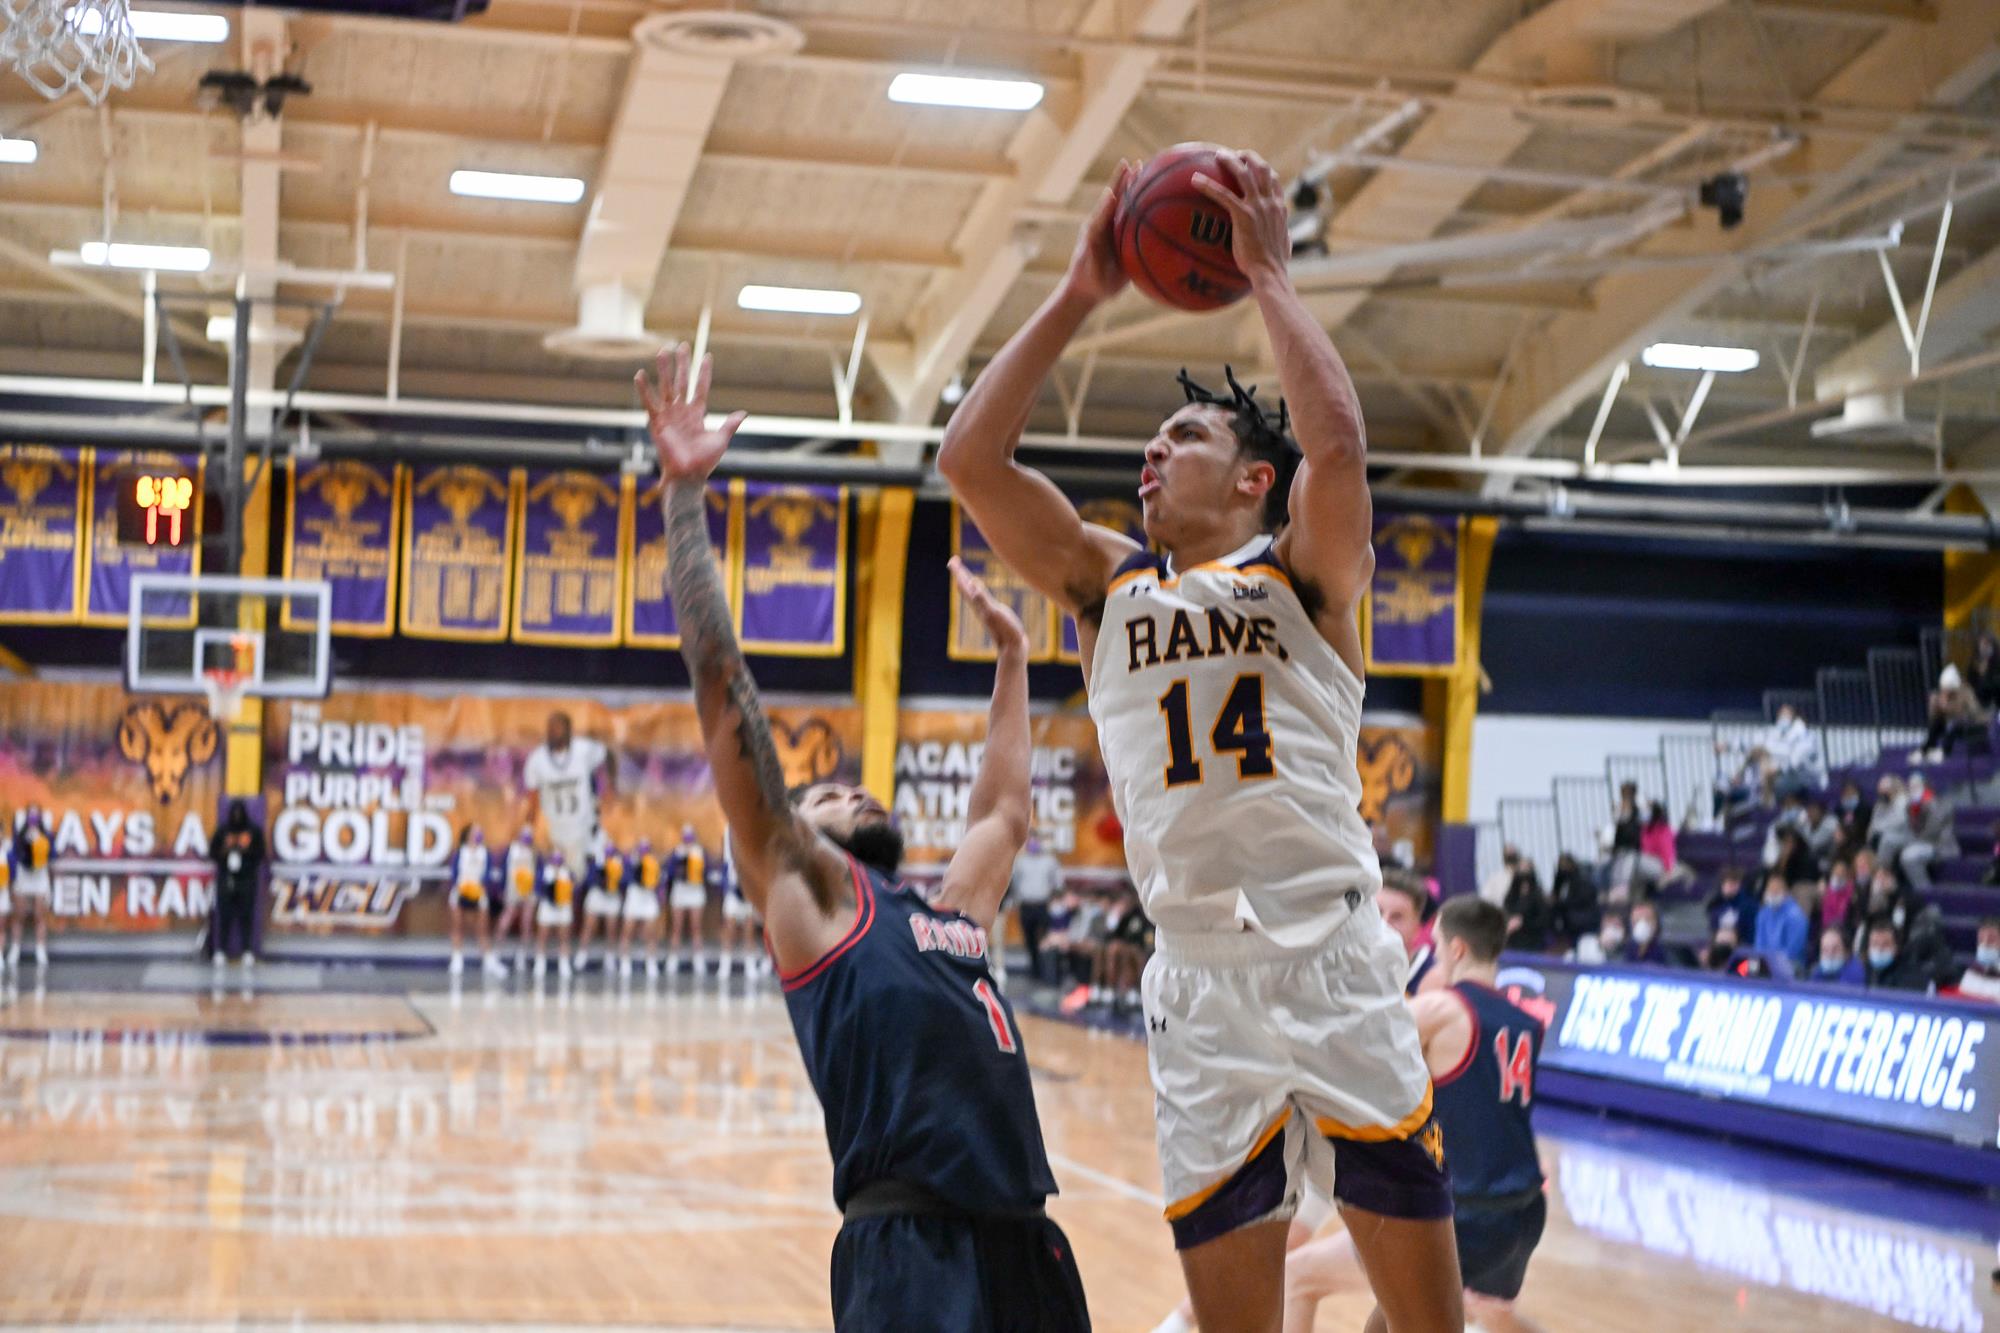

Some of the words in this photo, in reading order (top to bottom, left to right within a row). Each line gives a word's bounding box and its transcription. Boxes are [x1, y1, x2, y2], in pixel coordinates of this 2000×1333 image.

[1125, 606, 1289, 673] RAMS
[288, 721, 423, 767] PRIDE
[895, 740, 1076, 779] ACAIC
[1158, 672, 1277, 791] 14
[285, 772, 424, 810] PURPLE
[895, 782, 1075, 821] ATHIC
[273, 808, 453, 866] GOLD
[973, 978, 1017, 1055] 1
[1558, 973, 1641, 1055] TASTE
[1629, 982, 1690, 1062] THE
[1677, 990, 1783, 1075] PRIMO
[1773, 1001, 1986, 1113] DIFFERENCE.
[1494, 1026, 1532, 1108] 14
